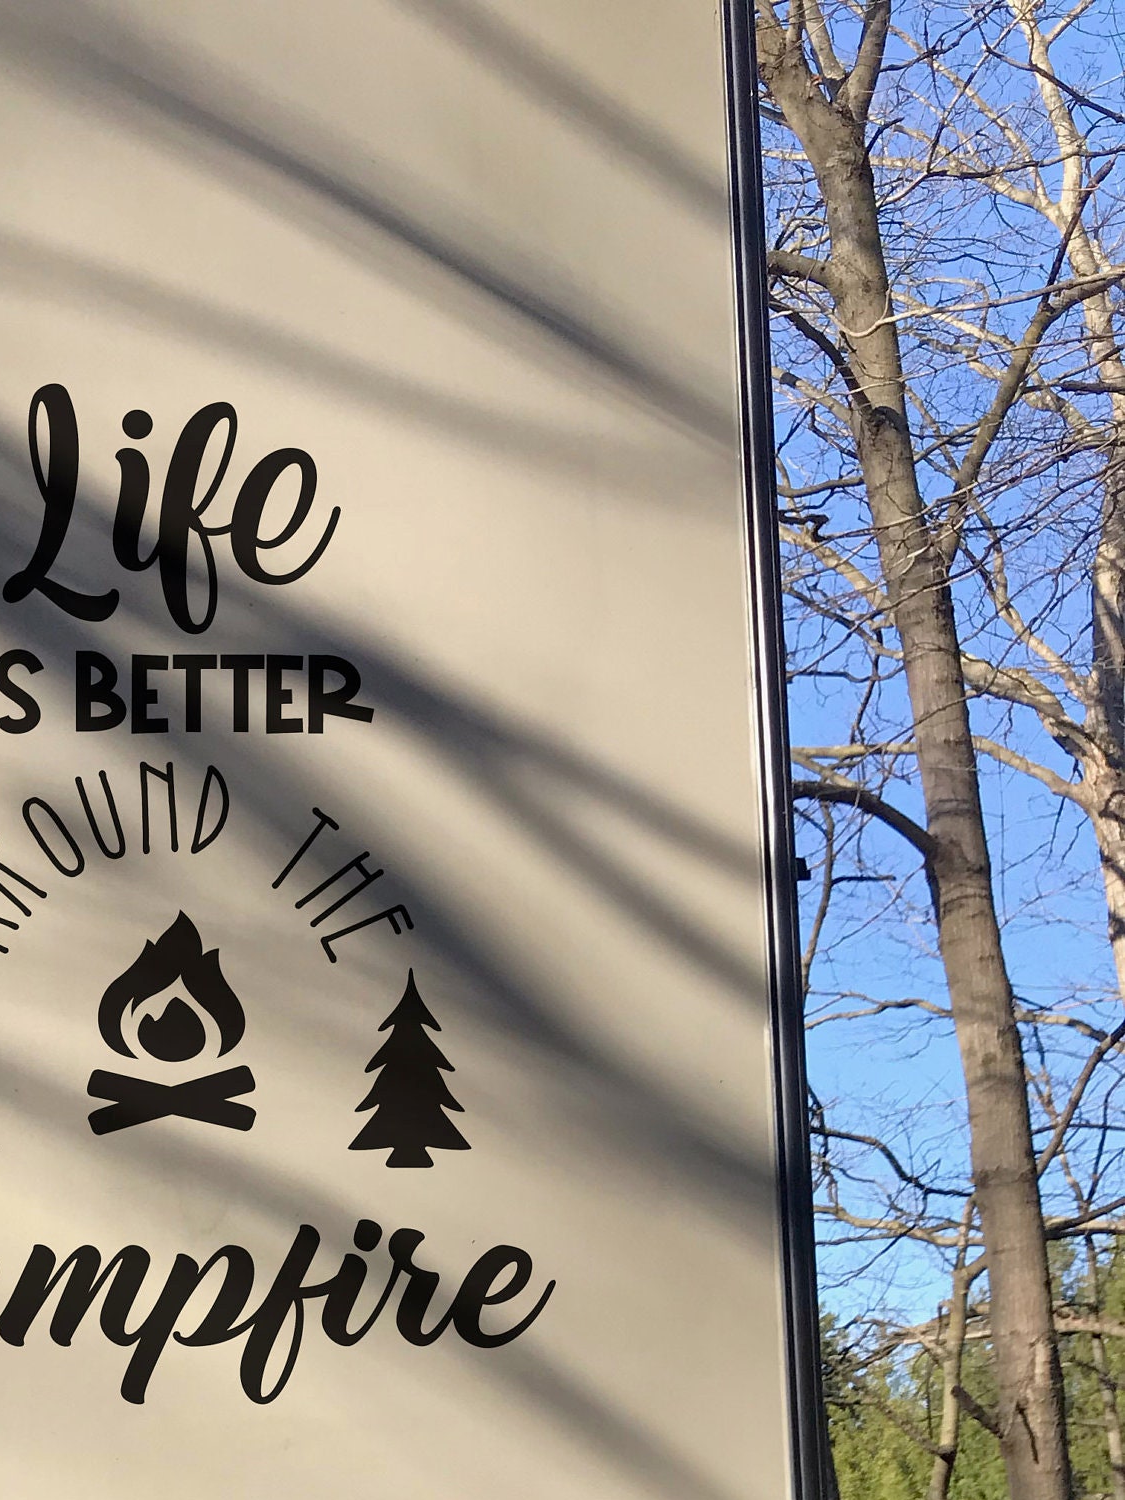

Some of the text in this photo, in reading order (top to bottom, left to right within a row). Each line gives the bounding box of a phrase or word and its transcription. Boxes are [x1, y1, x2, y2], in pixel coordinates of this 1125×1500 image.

[0, 382, 343, 636] Life
[74, 649, 376, 736] BETTER
[271, 805, 416, 965] THE
